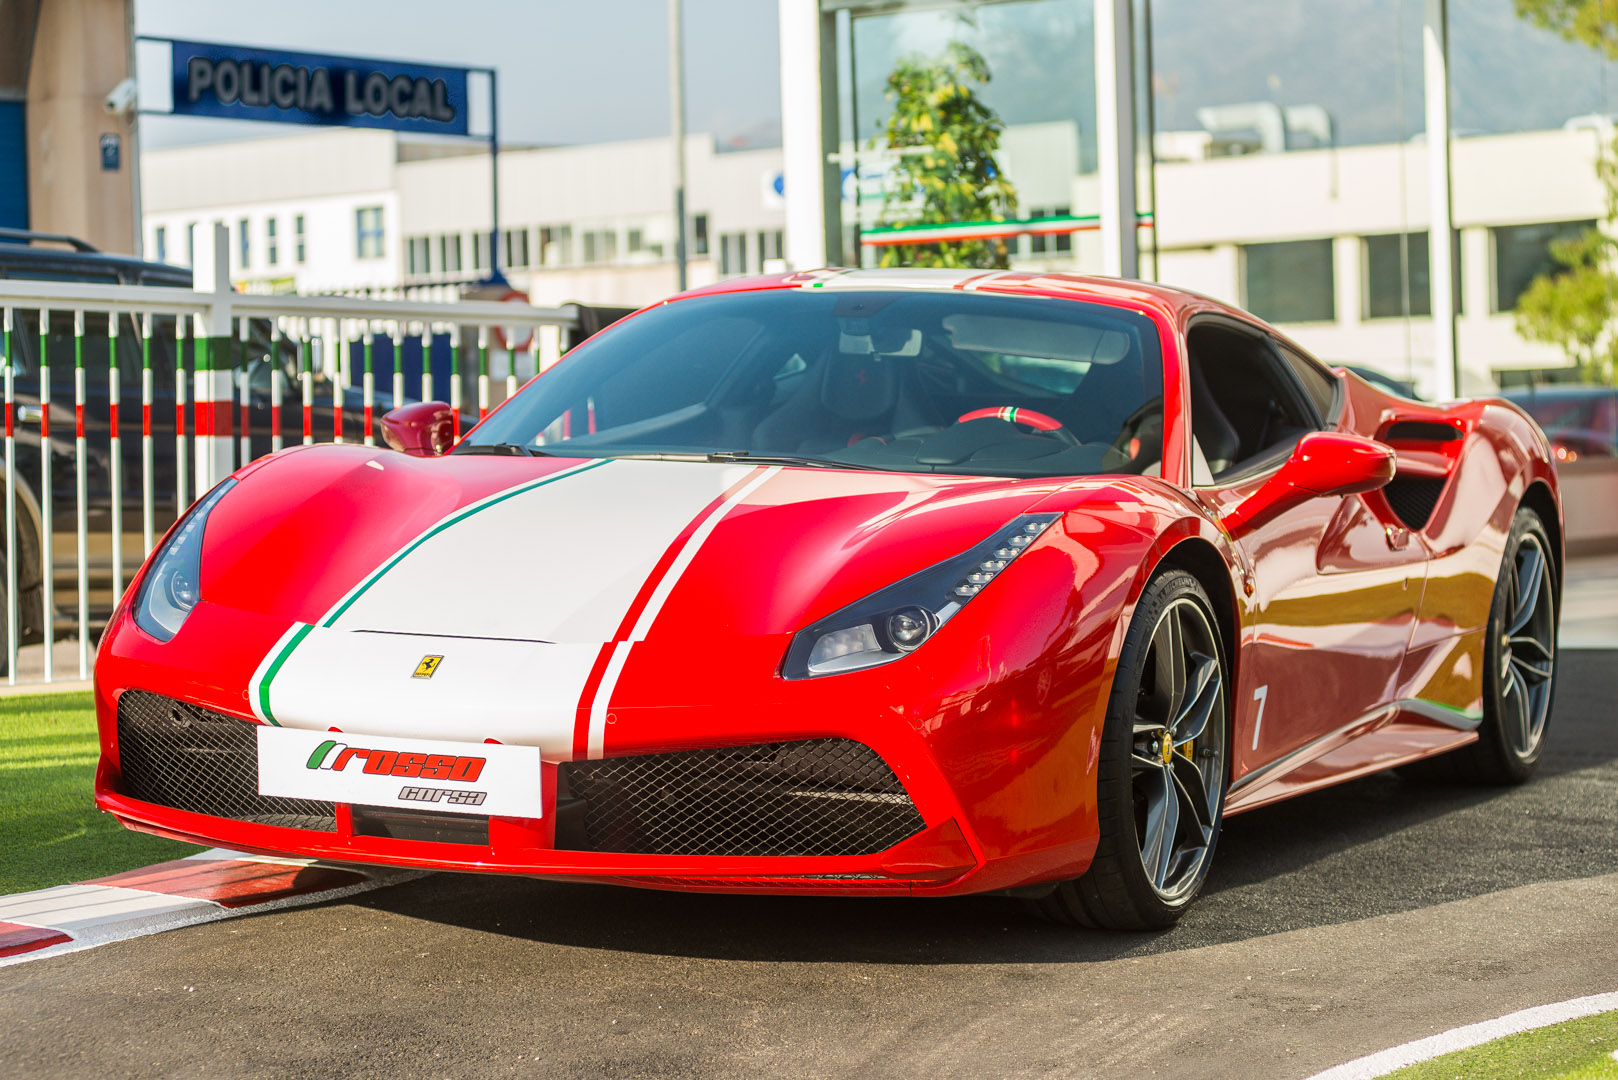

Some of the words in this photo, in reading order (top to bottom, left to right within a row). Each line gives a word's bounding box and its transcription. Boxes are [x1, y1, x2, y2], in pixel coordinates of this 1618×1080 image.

[188, 57, 333, 113] POLICIA
[344, 69, 456, 123] LOCAL
[1252, 684, 1268, 751] 7
[332, 747, 487, 783] rosso
[398, 786, 488, 806] corsa
